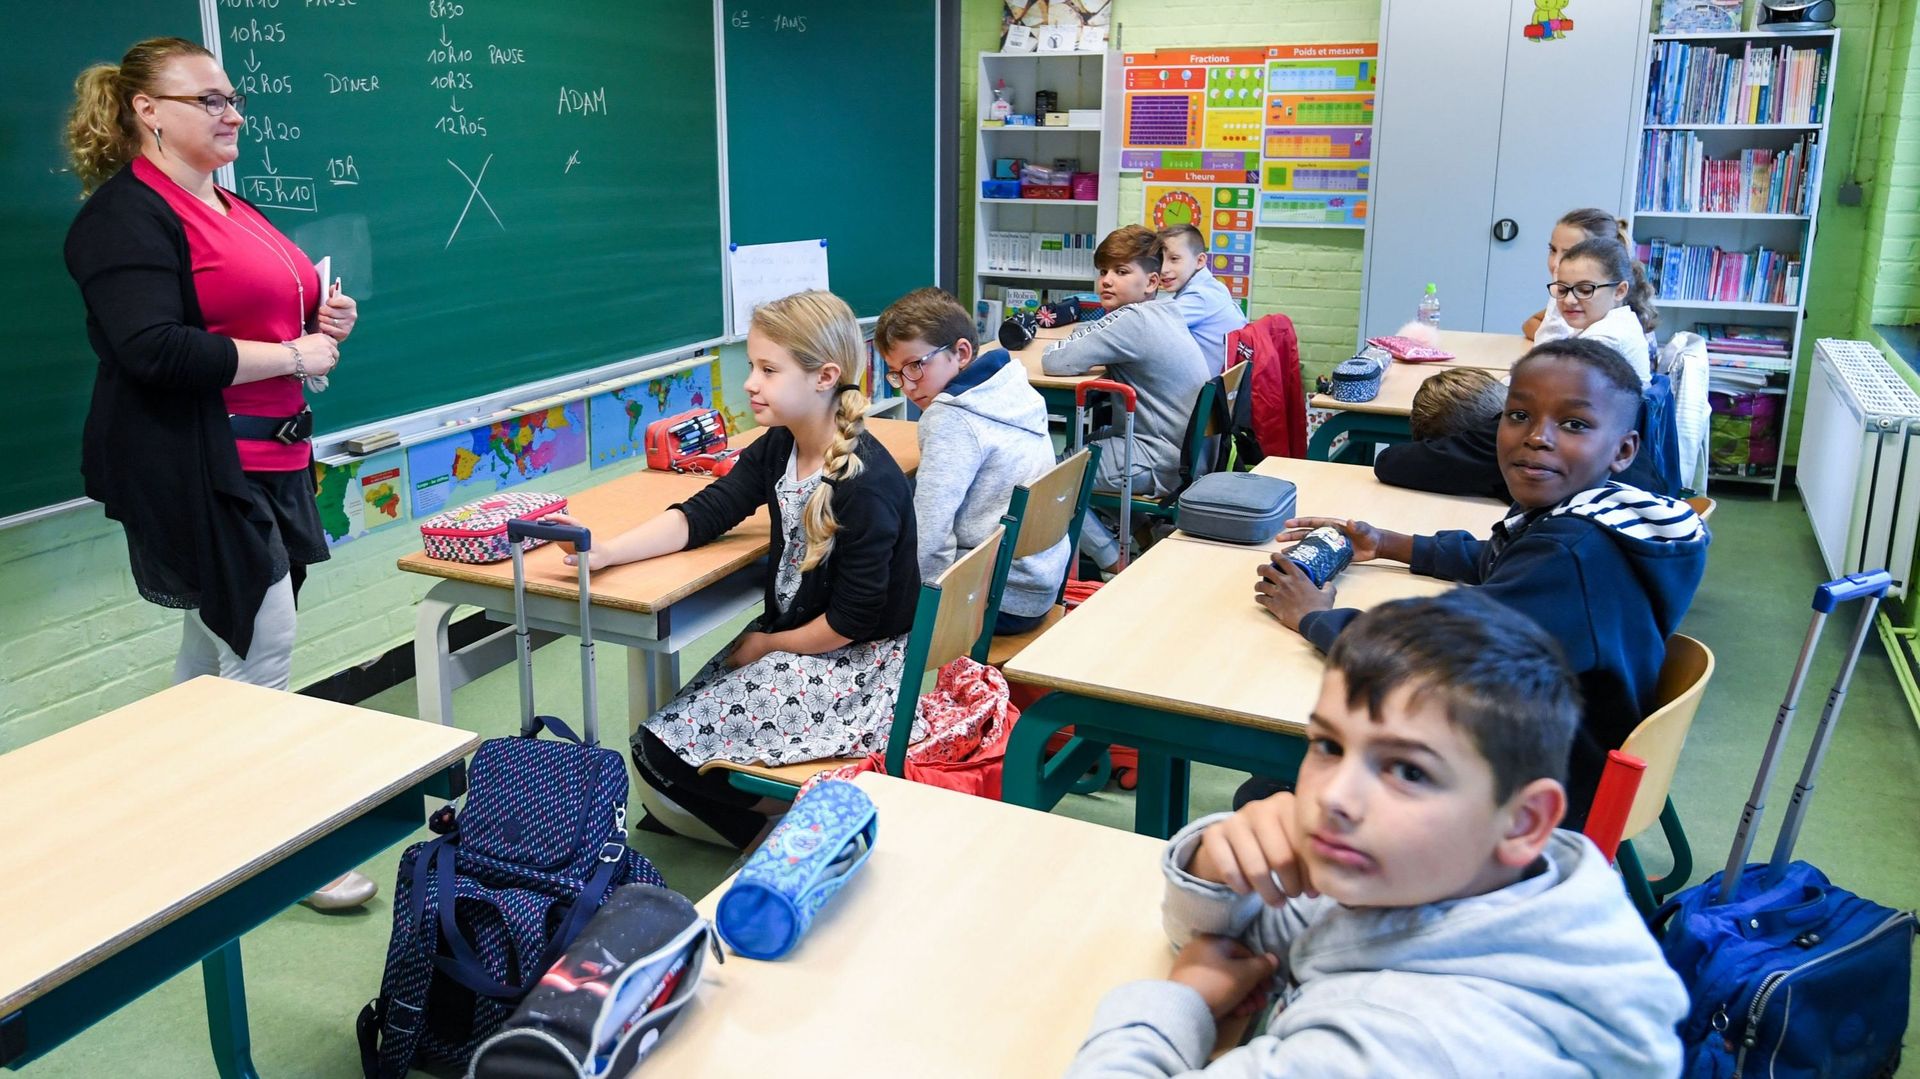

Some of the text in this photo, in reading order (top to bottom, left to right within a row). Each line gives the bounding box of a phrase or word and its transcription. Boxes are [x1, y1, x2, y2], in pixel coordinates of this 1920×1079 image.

[429, 0, 464, 18] 8h30
[230, 18, 286, 43] 10h25
[427, 45, 526, 64] 10h10 PAUSE
[1190, 54, 1230, 63] Fractions
[1293, 47, 1316, 56] Poids
[1328, 47, 1365, 55] mesures
[236, 72, 380, 94] 12h05 DÎNER
[430, 70, 474, 90] 10h25
[558, 86, 607, 116] ADAM
[241, 115, 300, 143] 13h20
[435, 115, 487, 137] 12h05
[1185, 172, 1215, 180] L'heure
[250, 177, 311, 203] 15h10
